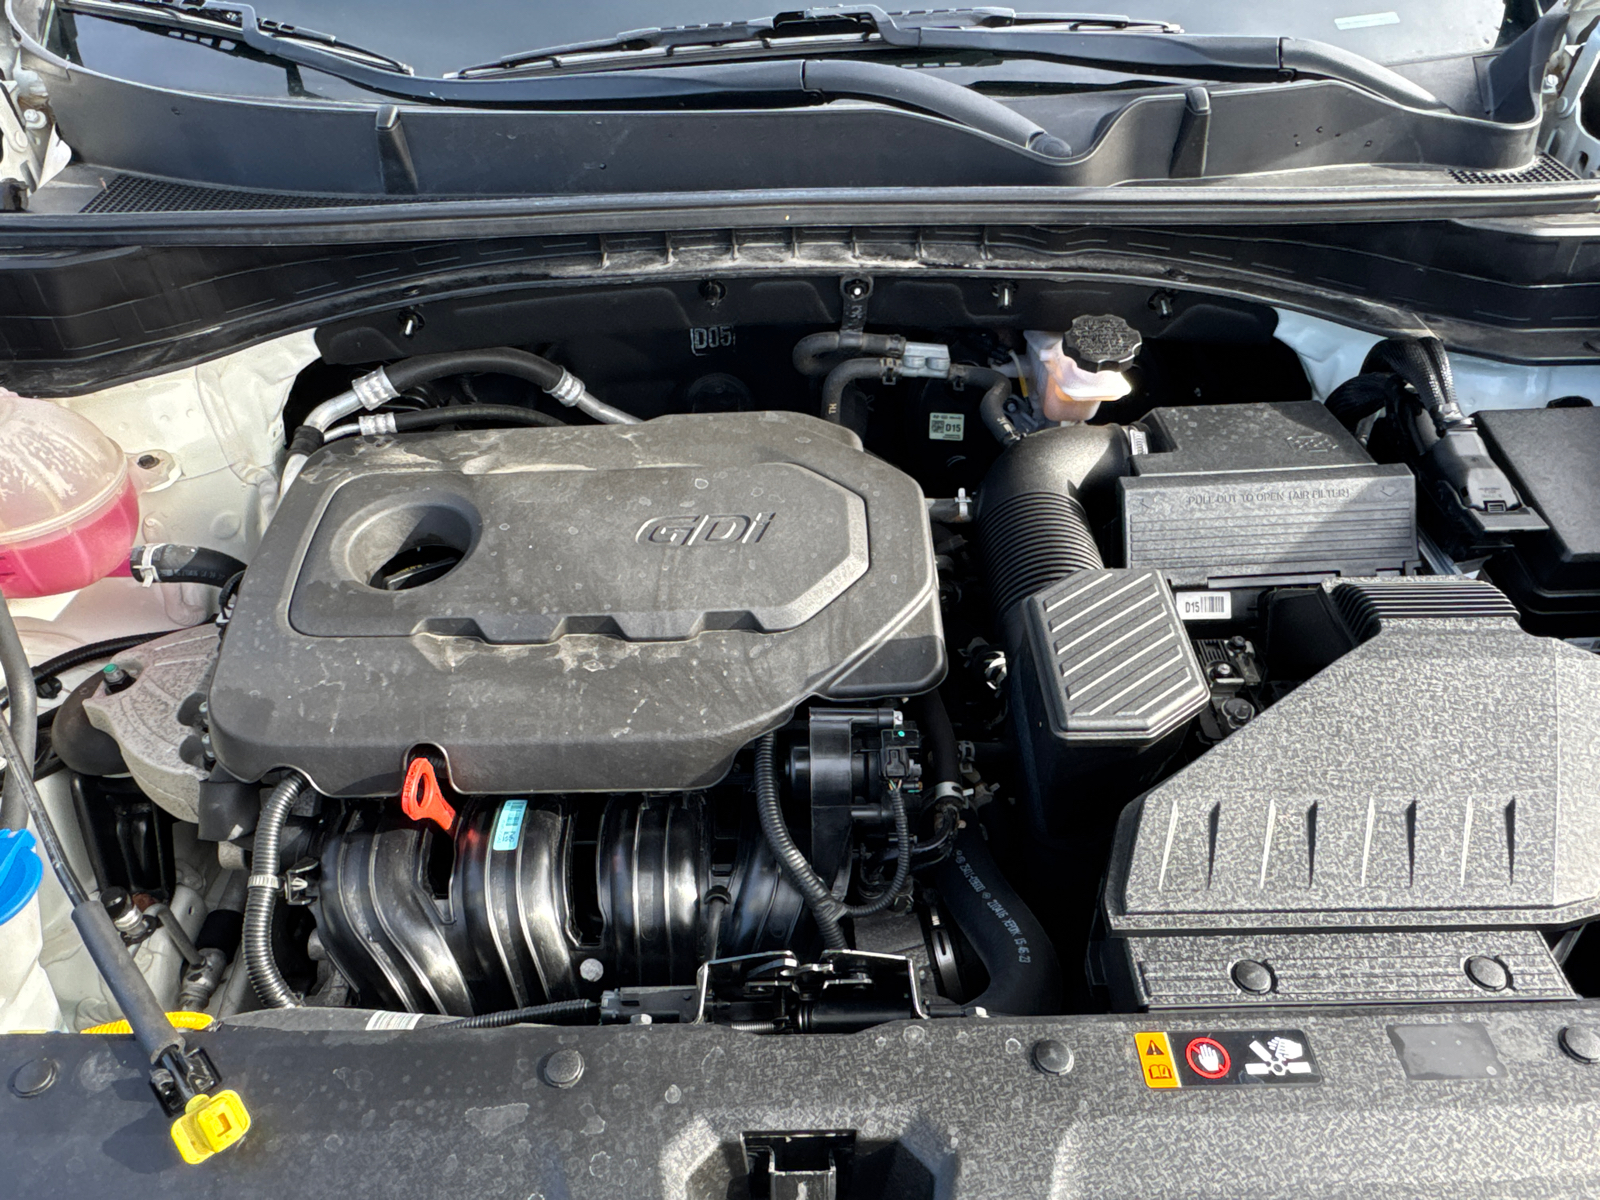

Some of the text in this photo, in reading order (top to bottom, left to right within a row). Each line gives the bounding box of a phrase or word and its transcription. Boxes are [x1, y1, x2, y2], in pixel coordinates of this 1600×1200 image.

[1188, 488, 1350, 505] PULL OUT TO OPEN (AIR FILTER)
